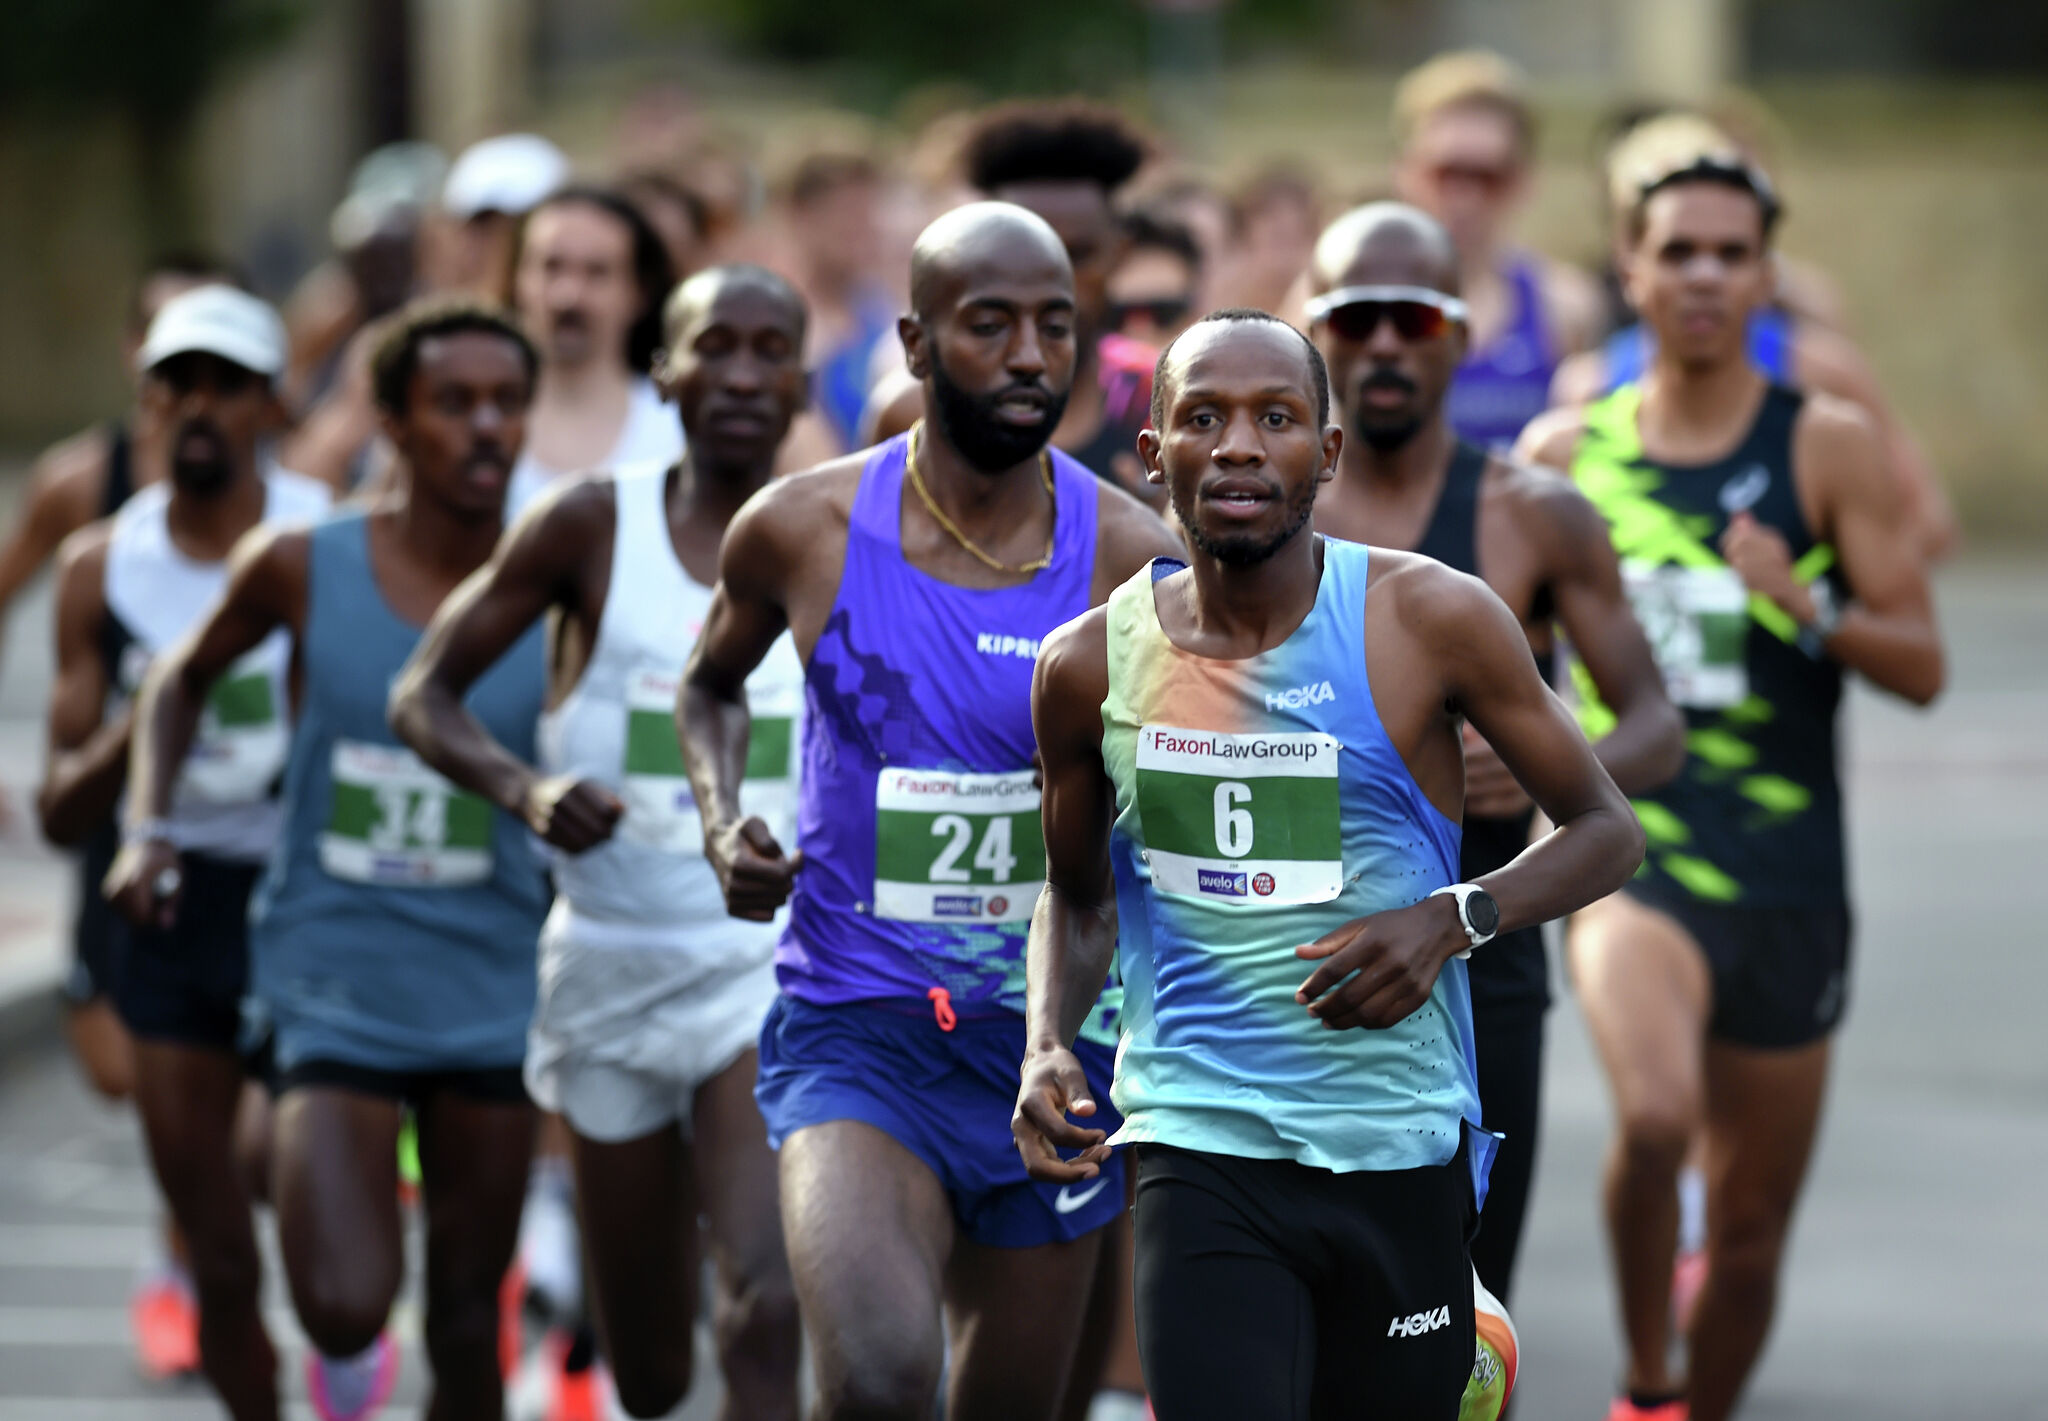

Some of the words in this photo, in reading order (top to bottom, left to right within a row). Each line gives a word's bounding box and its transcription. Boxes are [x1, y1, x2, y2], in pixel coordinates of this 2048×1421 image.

[1265, 680, 1336, 712] HOKA
[1154, 732, 1318, 761] FaxonLawGroup
[896, 775, 1032, 797] FaxonLawGro
[1213, 781, 1254, 858] 6
[928, 814, 1017, 882] 24
[1200, 874, 1233, 889] avelo
[1387, 1304, 1451, 1338] HOKA
